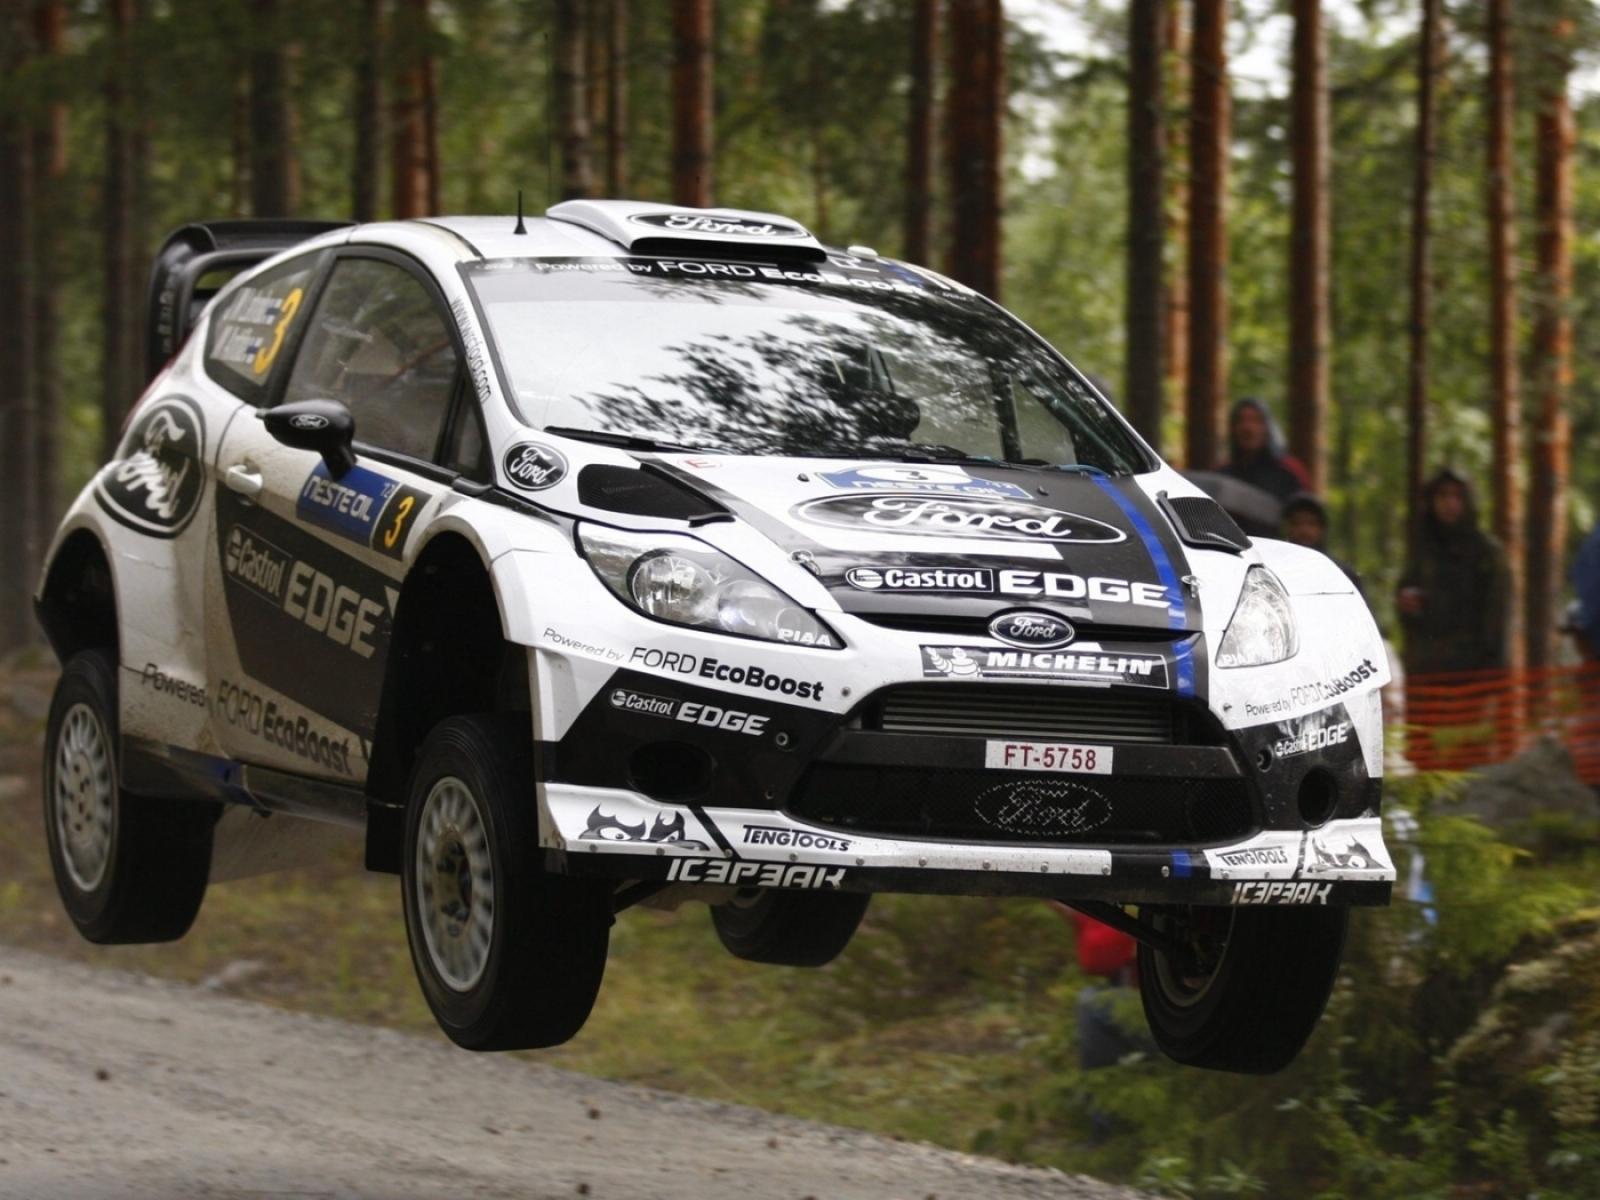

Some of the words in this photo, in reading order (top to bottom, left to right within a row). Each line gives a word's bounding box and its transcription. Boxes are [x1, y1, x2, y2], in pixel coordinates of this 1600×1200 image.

[664, 215, 777, 236] Ford
[627, 263, 652, 273] by
[656, 260, 756, 278] FORD
[254, 287, 303, 375] 3
[510, 446, 557, 485] Ford
[384, 495, 415, 548] 3
[863, 497, 1072, 536] Ford
[238, 540, 285, 597] Castrol
[283, 560, 384, 659] EDGE
[884, 569, 987, 590] Castrol
[999, 570, 1172, 609] EDGE
[777, 629, 832, 648] PIAA
[1009, 616, 1057, 638] Ford
[543, 627, 605, 657] Powered
[606, 647, 624, 662] by
[628, 646, 697, 676] FORD
[699, 657, 825, 703] EcoBoost
[986, 651, 1153, 676] MICHELIN
[624, 692, 675, 717] Castrol
[676, 701, 770, 737] EDGE
[263, 701, 353, 776] EcoBoost
[1307, 720, 1350, 752] EDGE
[1004, 744, 1097, 771] FT-5758
